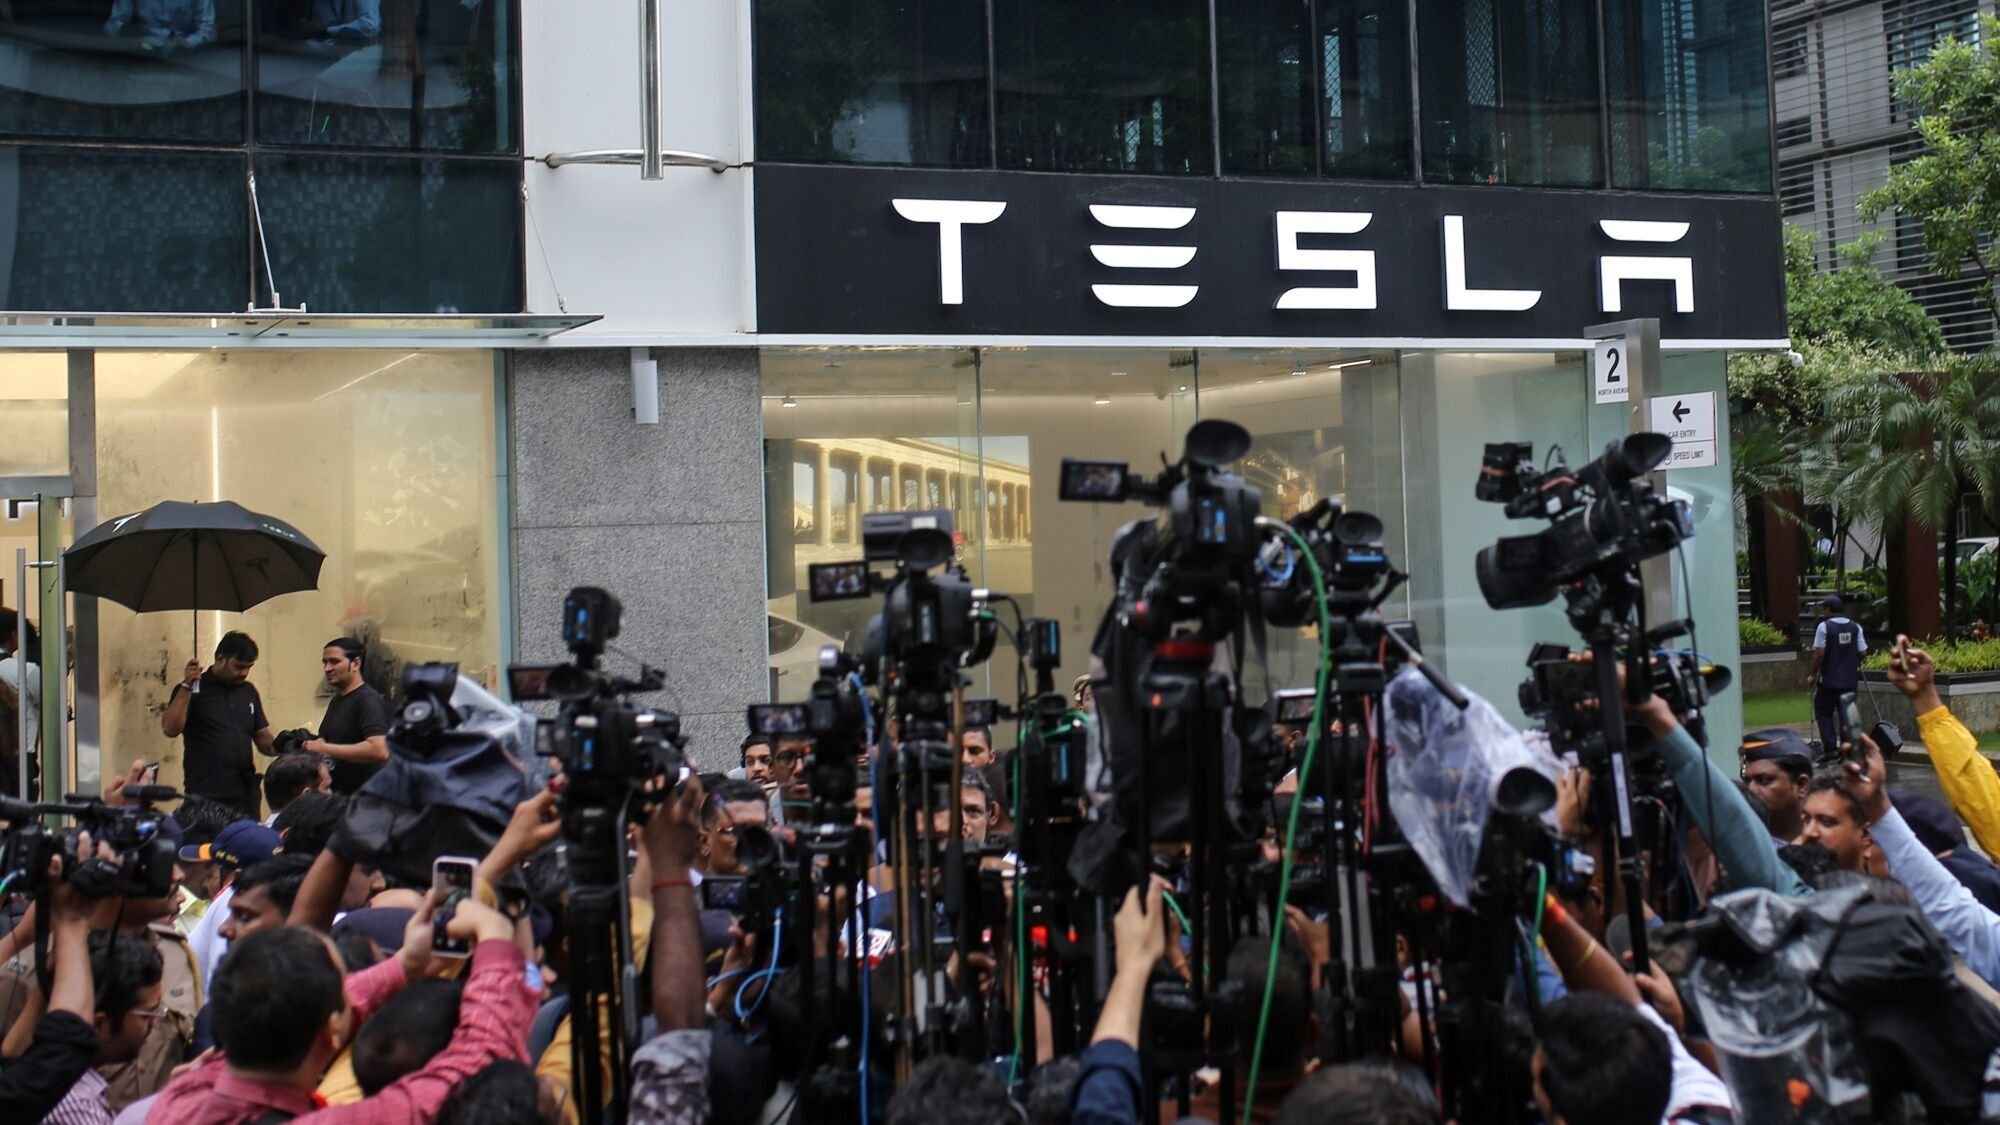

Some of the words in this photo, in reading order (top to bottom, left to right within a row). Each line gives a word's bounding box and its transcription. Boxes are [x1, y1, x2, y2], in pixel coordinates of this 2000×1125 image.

[891, 198, 1695, 313] TESLA
[1606, 347, 1620, 383] 2
[1680, 429, 1696, 438] ENTRY
[1673, 451, 1690, 460] SPEED
[1691, 450, 1704, 459] LIMIT
